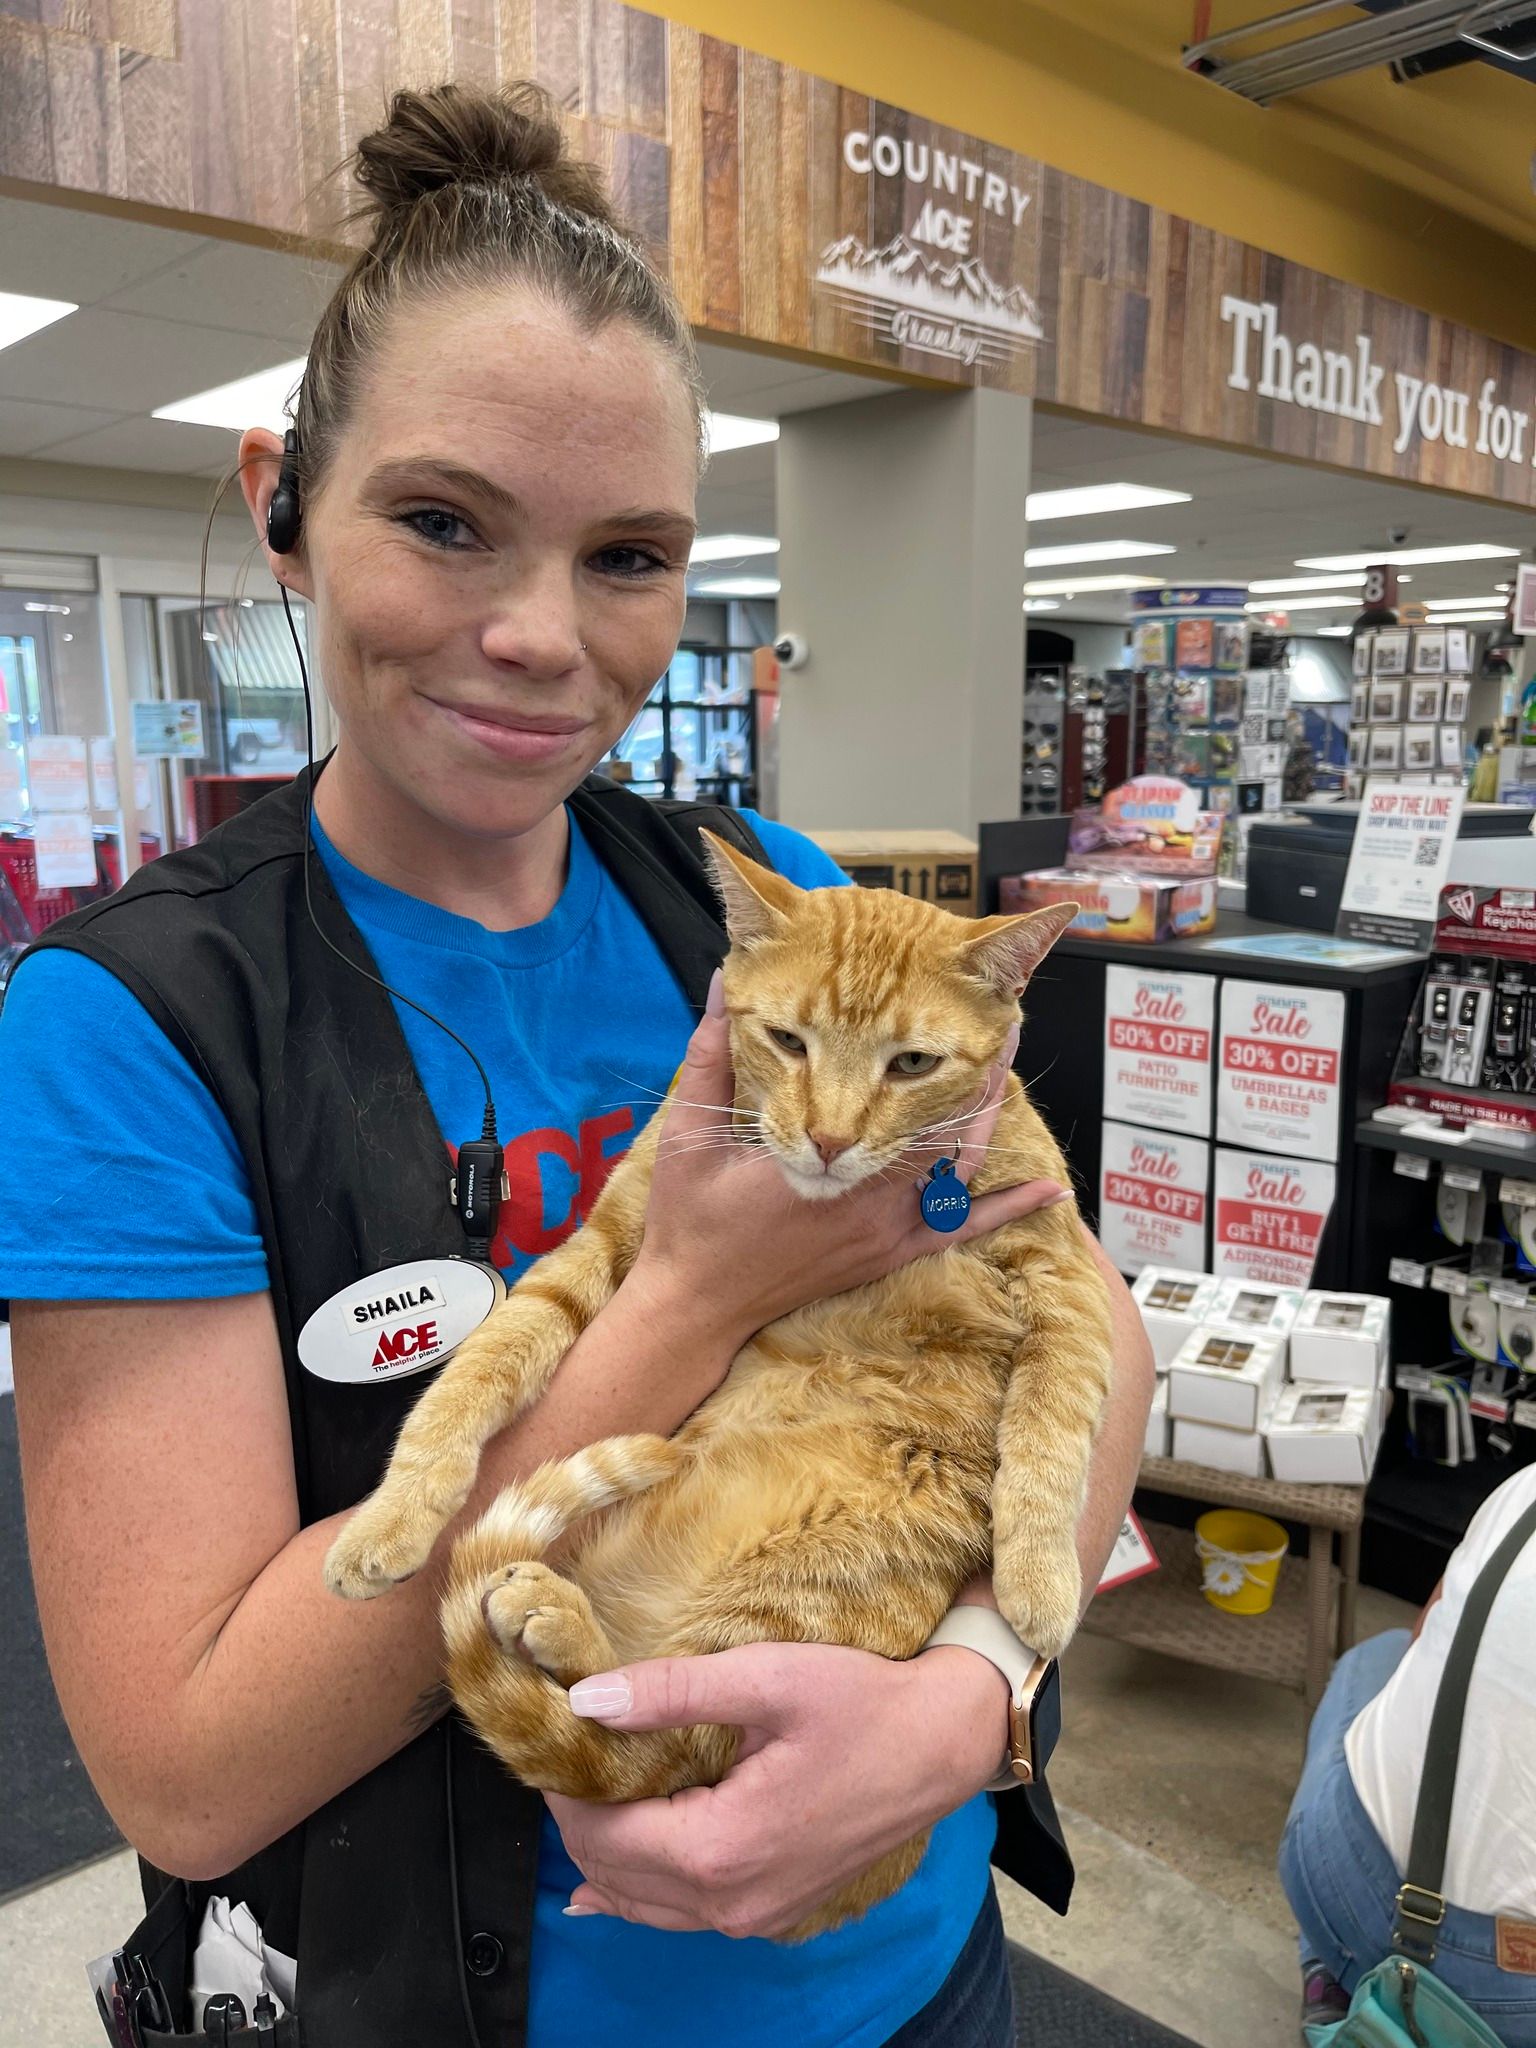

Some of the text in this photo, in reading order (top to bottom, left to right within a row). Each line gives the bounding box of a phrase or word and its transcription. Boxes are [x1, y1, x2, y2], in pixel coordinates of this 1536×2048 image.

[843, 131, 1031, 226] COUNTRY
[911, 199, 973, 255] ACE
[891, 309, 982, 366] Granby
[1219, 294, 1384, 426] Thank
[1393, 371, 1470, 454] you
[1475, 377, 1529, 464] for
[1365, 570, 1385, 602] 8
[1370, 795, 1453, 817] SKIP THE LINE
[1132, 988, 1186, 1021] Sale
[1251, 1003, 1312, 1039] Sale
[1114, 1023, 1205, 1056] 50% OFF
[1138, 1059, 1177, 1076] PATIO
[1229, 1042, 1333, 1078] 30% OFF
[1117, 1071, 1199, 1096] FURNITURE
[1232, 1076, 1328, 1104] UMBRELLAS
[1258, 1097, 1310, 1117] BASES
[1429, 1098, 1461, 1114] MADE
[1463, 1104, 1475, 1117] IN
[1477, 1107, 1497, 1121] THE
[1128, 1145, 1180, 1180] Sale
[467, 1164, 475, 1208] MOTOROLA
[1109, 1178, 1199, 1217] 30% OFF
[1245, 1168, 1305, 1205] Sale
[926, 1195, 967, 1212] MORRIS
[1123, 1212, 1183, 1238] ALL FIRE
[1227, 1222, 1262, 1244] GET
[1252, 1210, 1301, 1233] BUY 1
[353, 1285, 434, 1323] SHAILA
[372, 1320, 438, 1367] ACE
[373, 1364, 389, 1373] The
[390, 1355, 417, 1368] helpful
